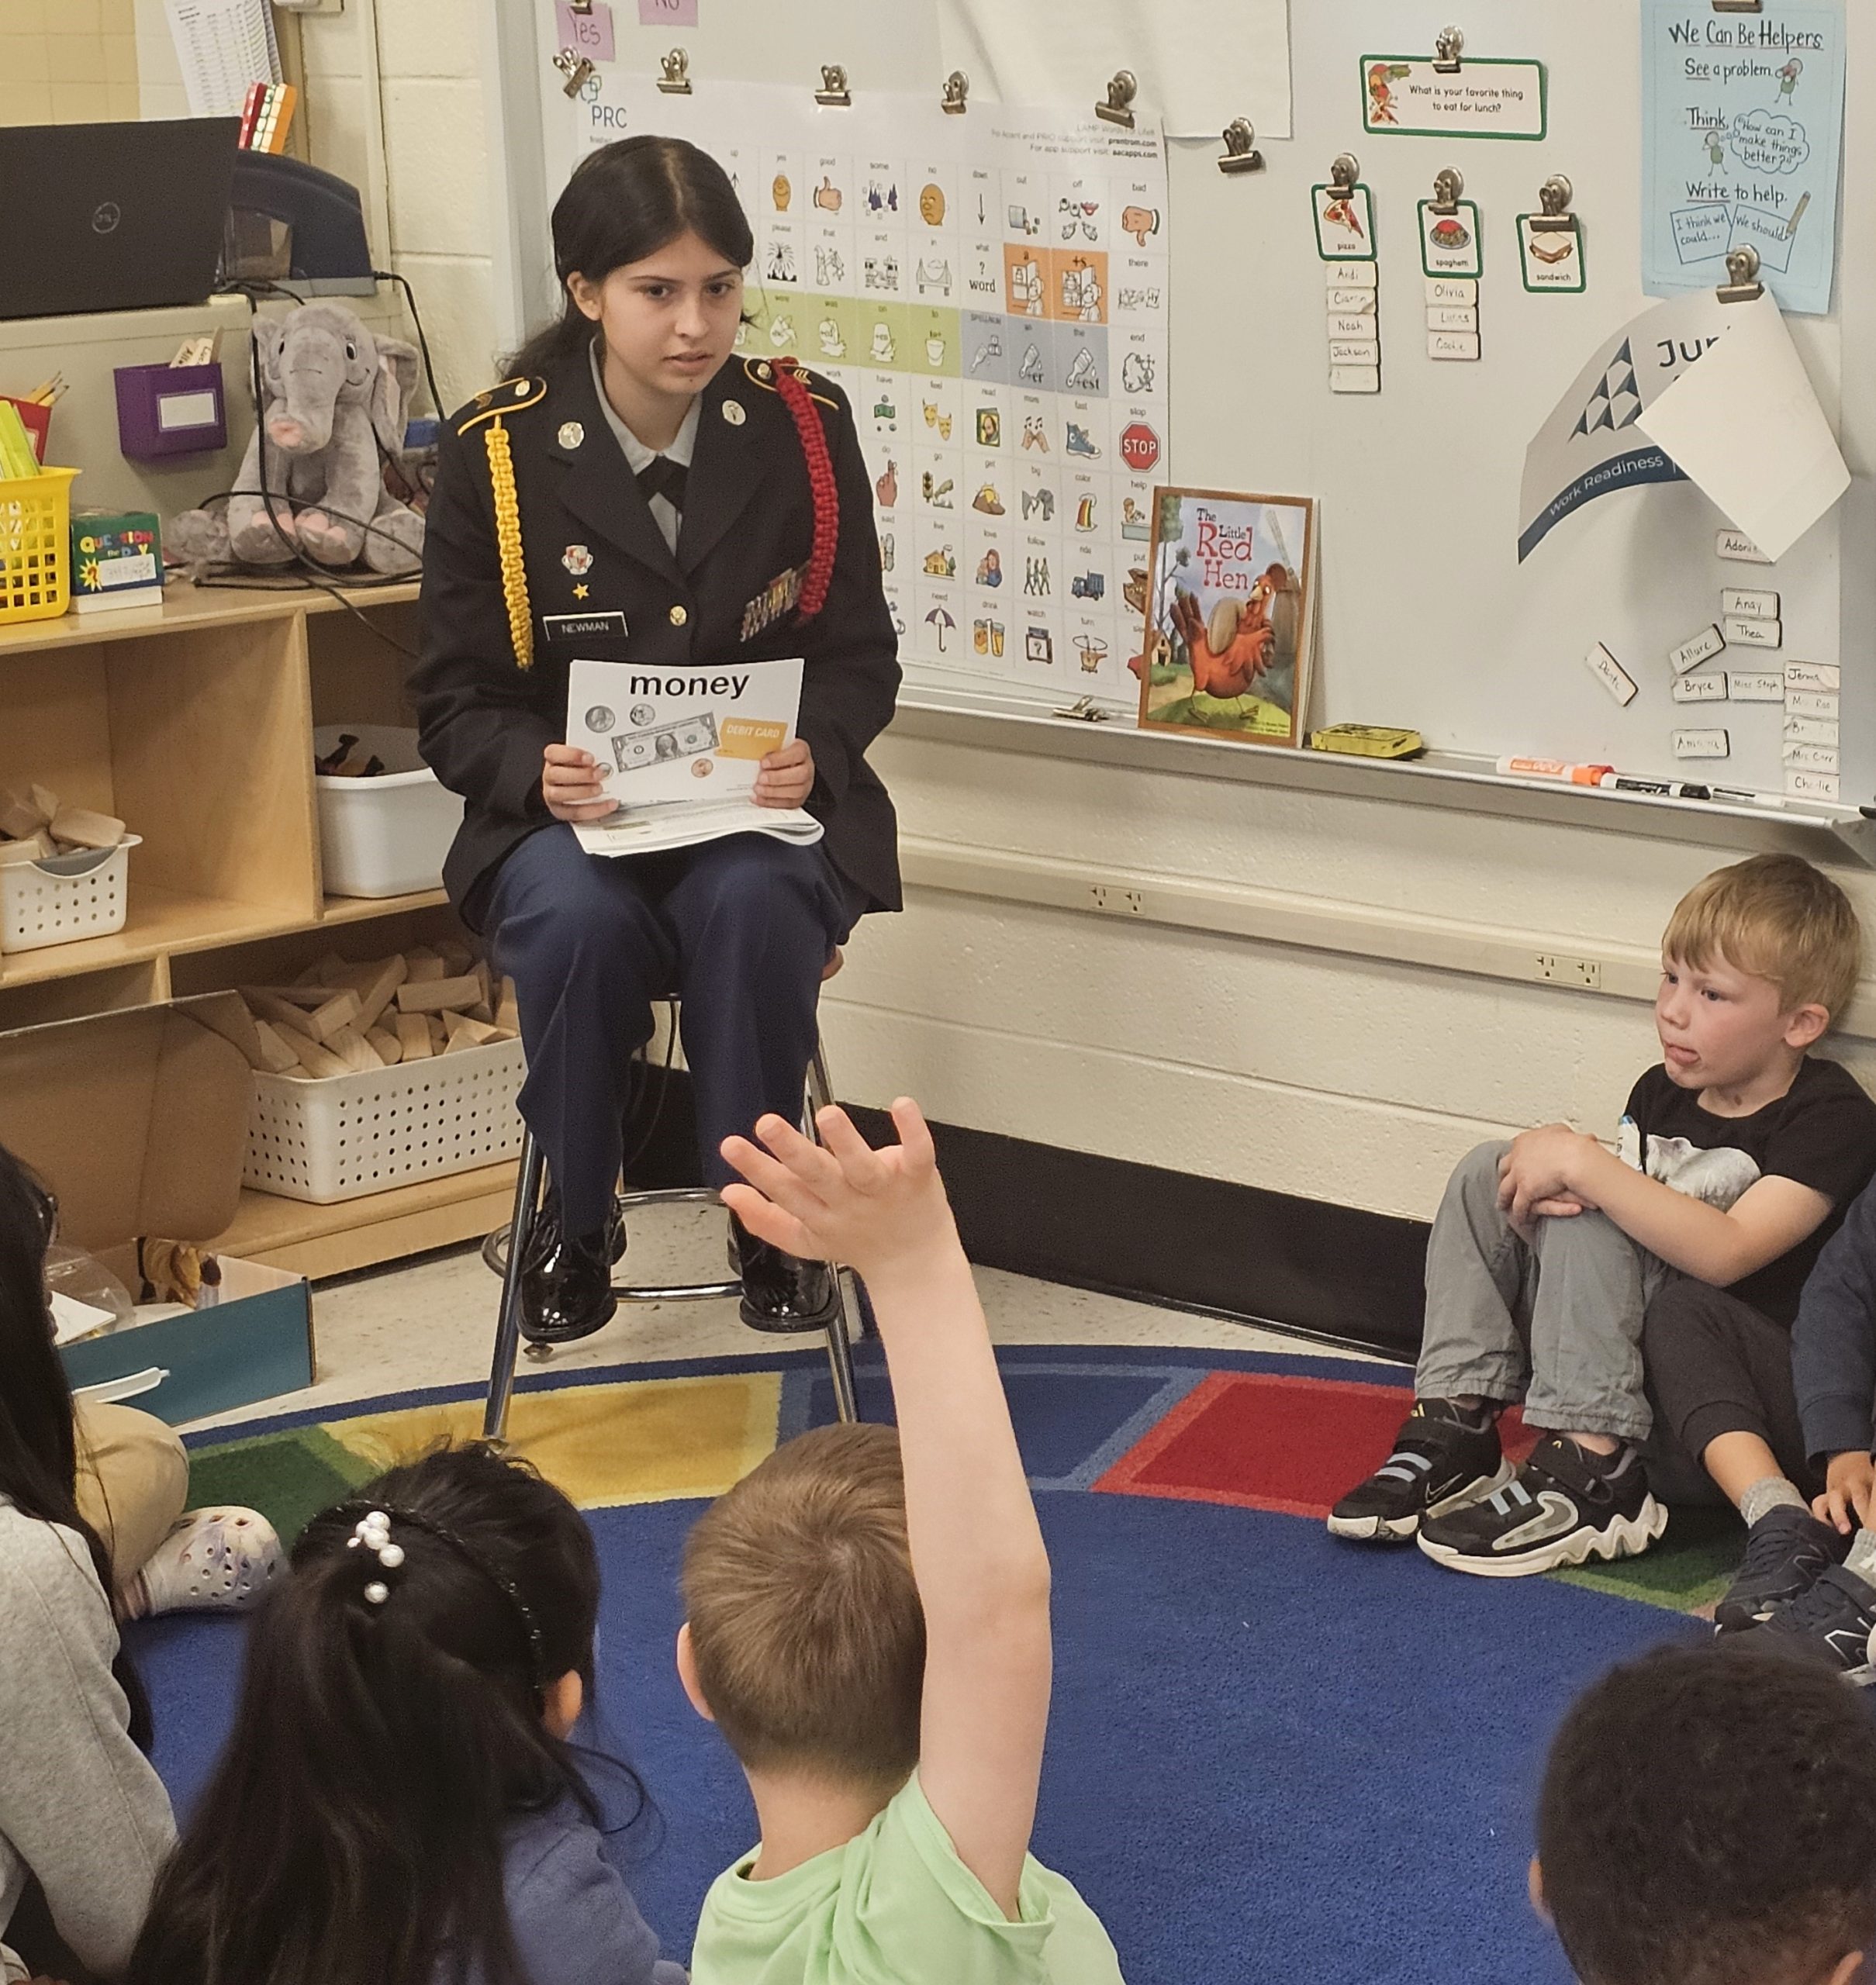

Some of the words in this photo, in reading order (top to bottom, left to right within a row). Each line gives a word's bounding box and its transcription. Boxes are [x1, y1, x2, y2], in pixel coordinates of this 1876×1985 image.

[568, 8, 601, 45] Yes
[1669, 19, 1700, 43] We
[1706, 19, 1733, 43] Can
[1738, 22, 1755, 45] Be
[1758, 19, 1823, 54] Helpers
[1684, 57, 1709, 76] See
[1713, 64, 1719, 76] a
[1723, 59, 1773, 85] problem.
[1409, 85, 1432, 95] What
[1435, 86, 1441, 95] is
[1444, 88, 1463, 98] your
[1466, 87, 1499, 98] favorite
[1501, 88, 1523, 101] thing
[1432, 102, 1442, 111] to
[1443, 102, 1457, 112] eat
[1460, 102, 1472, 112] for
[1474, 102, 1501, 113] lunch?
[592, 105, 627, 129] PRC
[1765, 125, 1784, 137] can
[1788, 128, 1797, 140] I
[1108, 137, 1157, 147] prentrom.com
[1739, 134, 1767, 147] make
[1771, 138, 1802, 158] things
[1030, 143, 1042, 152] For
[1045, 145, 1058, 154] app
[1112, 149, 1158, 159] aacapps.com
[820, 157, 836, 167] good
[869, 162, 890, 171] some
[1073, 180, 1083, 188] off
[1131, 183, 1147, 192] bad
[1686, 181, 1730, 199] Write
[1734, 183, 1749, 199] to
[1753, 183, 1788, 209] help.
[1675, 219, 1682, 230] I
[1686, 215, 1712, 230] think
[1712, 213, 1726, 224] we
[1736, 214, 1750, 229] We
[874, 233, 888, 242] and
[1128, 258, 1149, 268] there
[1536, 272, 1571, 281] sandwich
[969, 278, 997, 293] word
[1435, 284, 1464, 299] Olivia
[1338, 319, 1363, 331] Noah
[1130, 333, 1146, 343] end
[1332, 346, 1371, 357] Jackson
[1129, 407, 1147, 418] stop
[1123, 438, 1156, 455] STOP
[1075, 473, 1091, 482] color
[1549, 484, 1582, 516] Work
[1584, 454, 1665, 491] Readiness
[1131, 479, 1148, 492] help
[1196, 507, 1217, 522] The
[1218, 523, 1246, 540] Little
[80, 530, 154, 554] QUETION
[1196, 521, 1252, 561] Red
[121, 543, 149, 558] DY
[1133, 553, 1146, 562] put
[1204, 558, 1249, 590] Hen
[931, 592, 948, 602] need
[1026, 609, 1046, 619] watch
[561, 621, 610, 633] NEWMAN
[1680, 642, 1712, 664] Allure
[630, 674, 751, 700] money
[1684, 679, 1715, 696] Bryce
[726, 724, 753, 736] DEBIT
[755, 727, 780, 738] CARD
